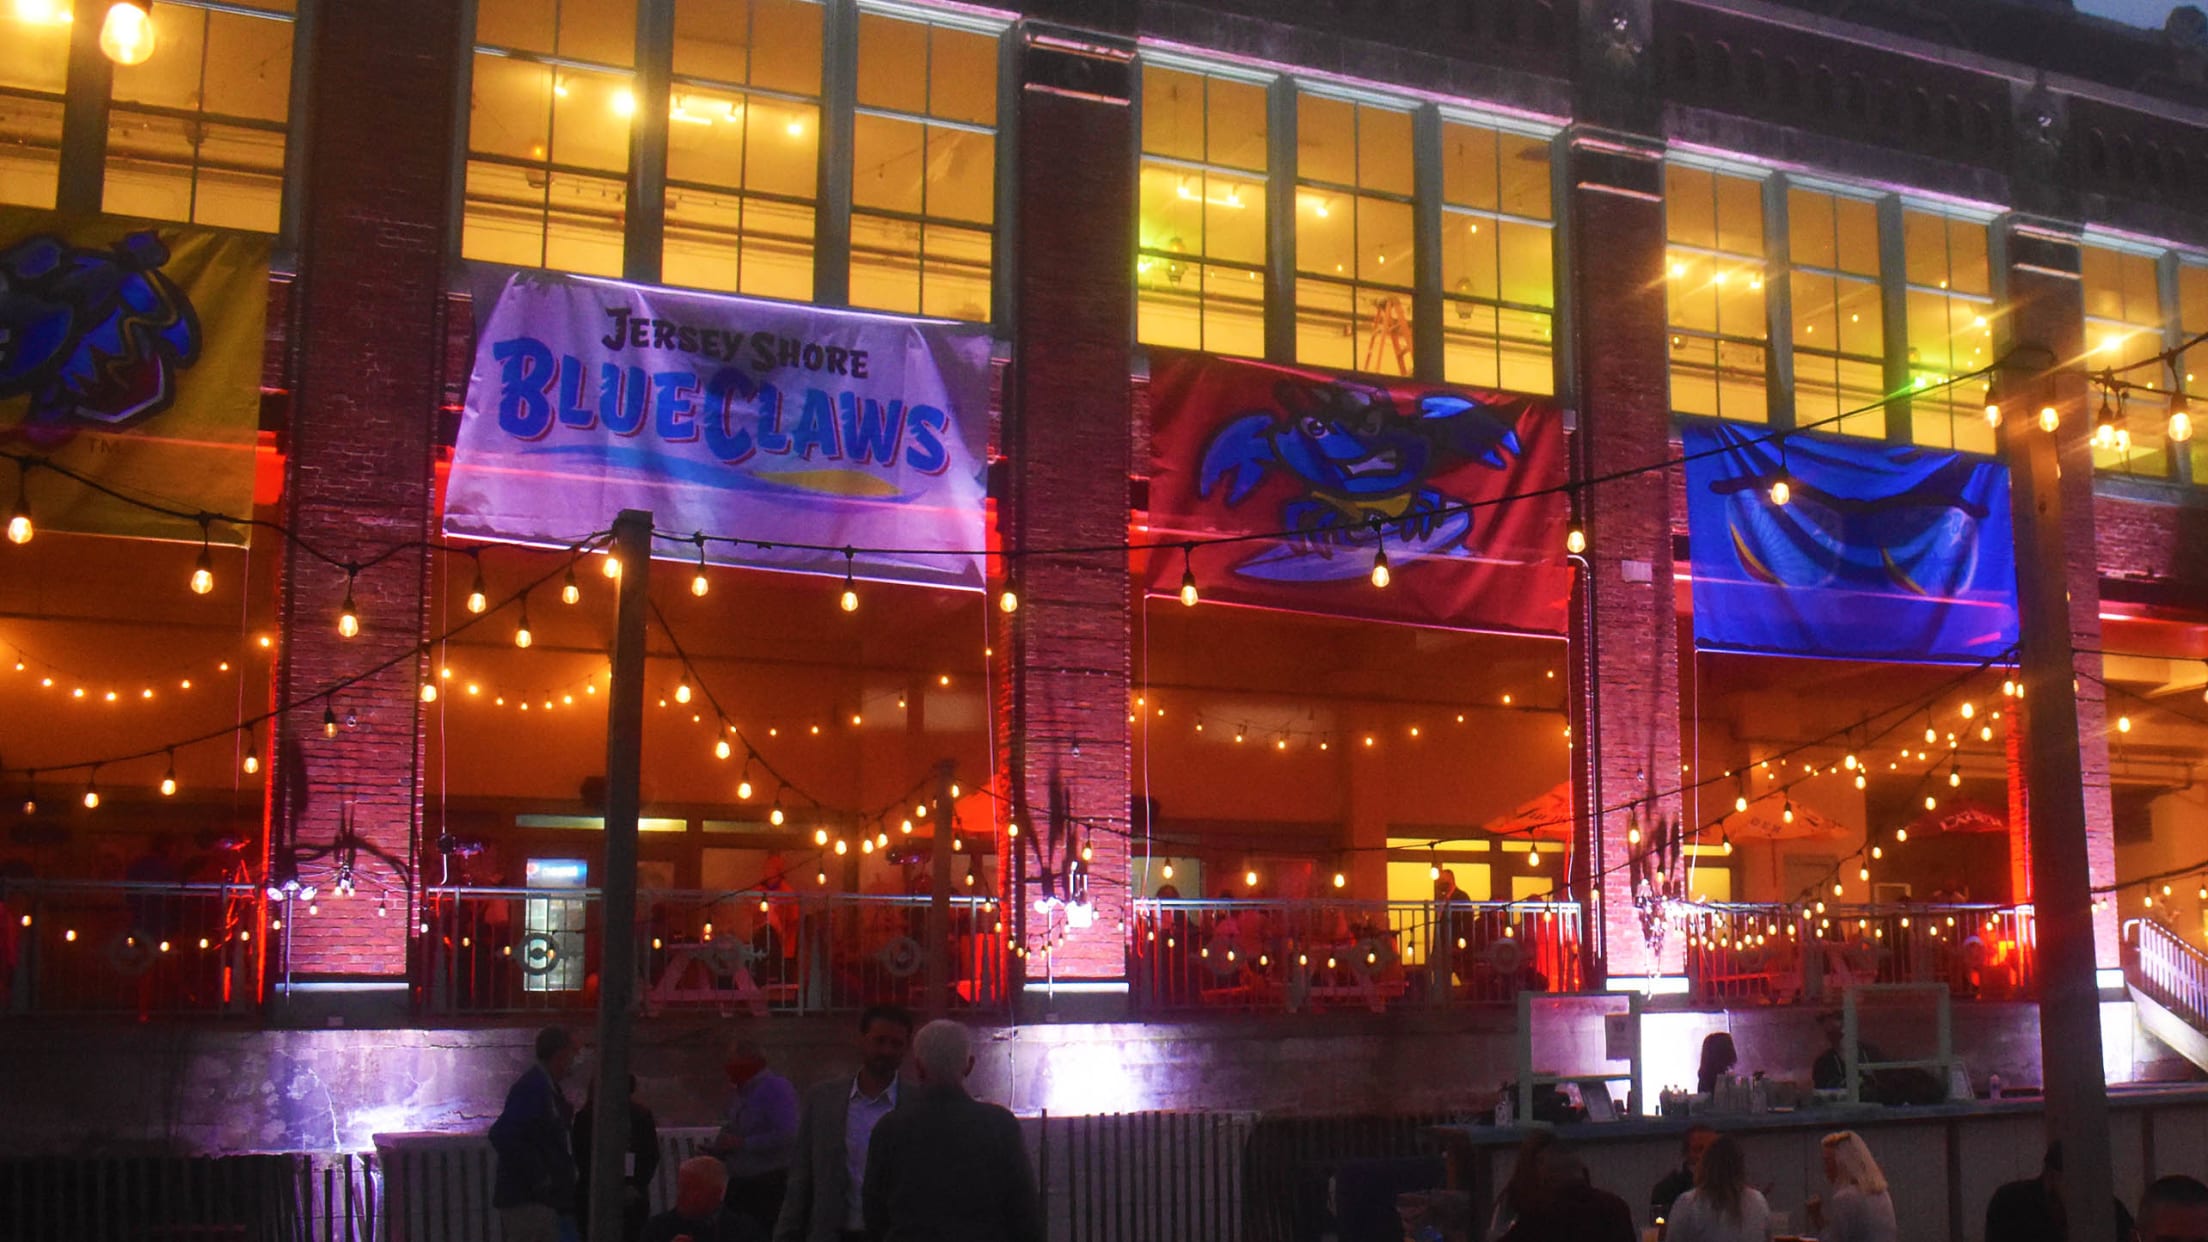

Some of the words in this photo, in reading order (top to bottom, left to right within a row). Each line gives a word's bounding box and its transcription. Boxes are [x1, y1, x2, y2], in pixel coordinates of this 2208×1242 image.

[601, 307, 746, 363] JERSEY
[750, 331, 869, 380] SHORE
[87, 436, 121, 454] TM
